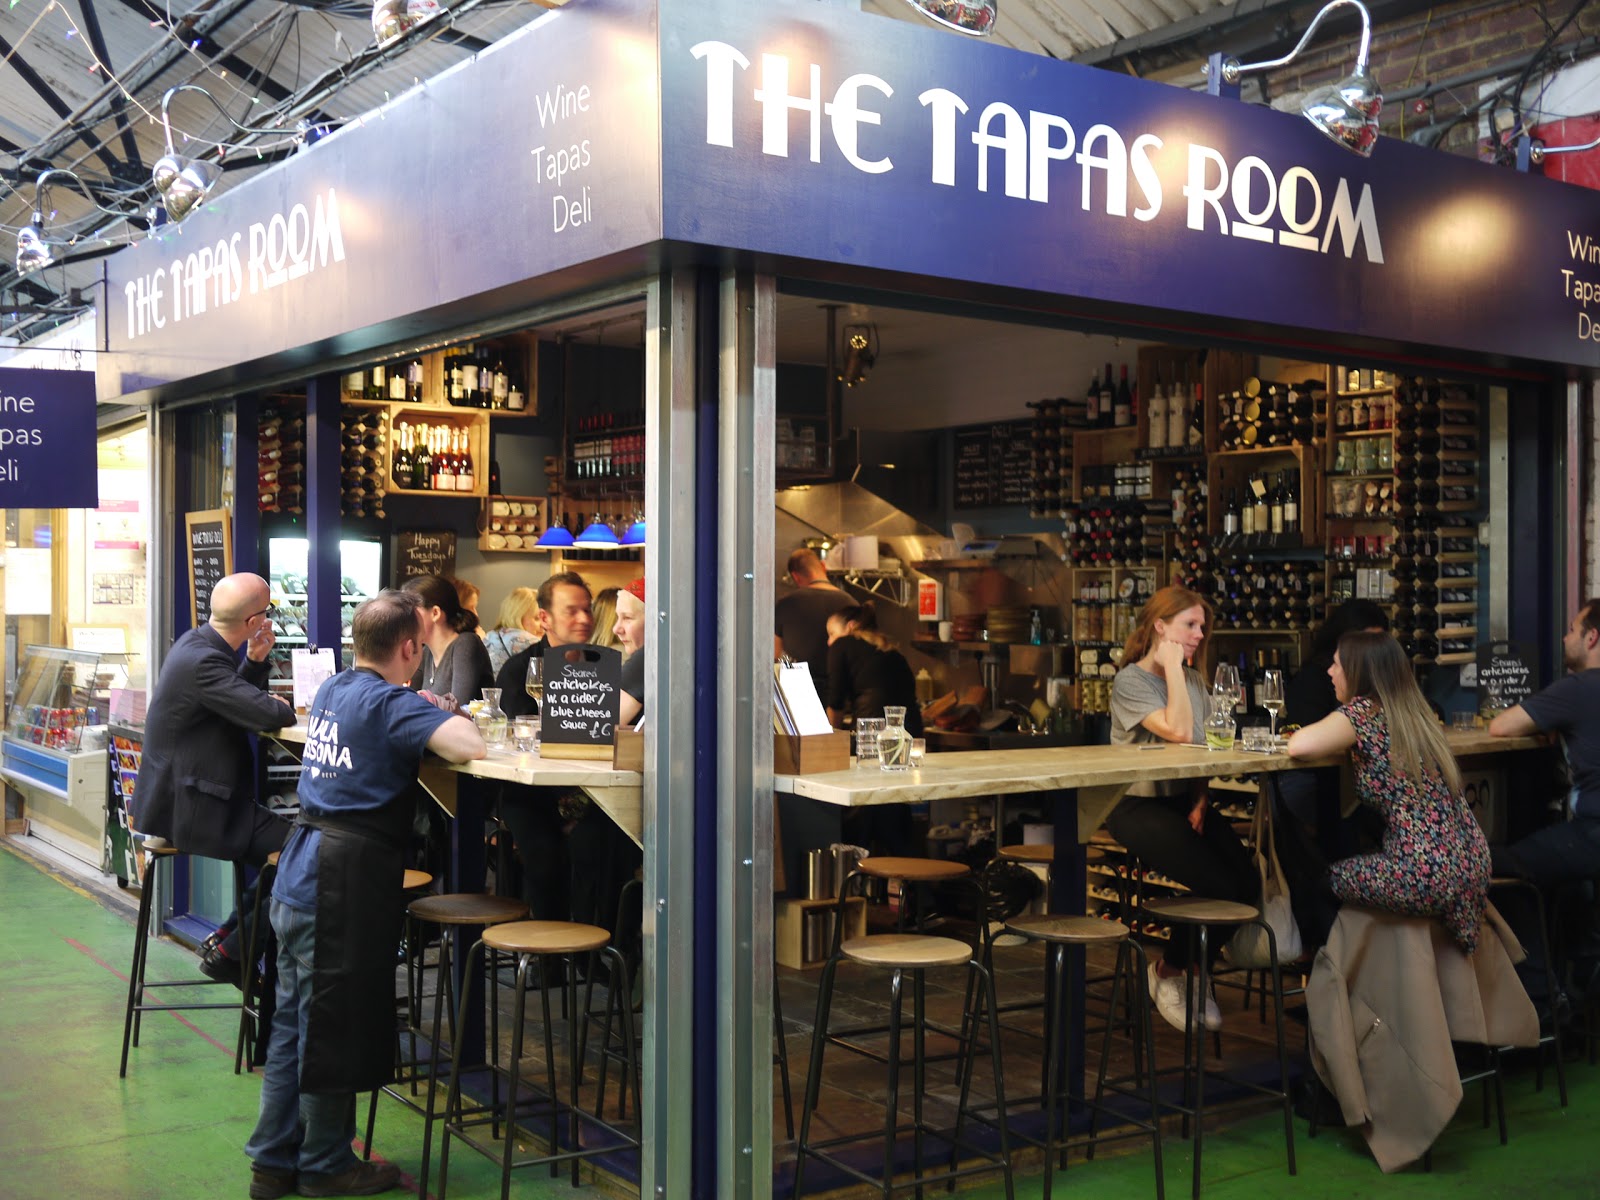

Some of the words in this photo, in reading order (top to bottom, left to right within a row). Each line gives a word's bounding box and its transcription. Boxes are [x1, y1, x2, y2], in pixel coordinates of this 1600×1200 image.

[535, 84, 591, 129] Wine
[530, 139, 591, 187] Tapas
[688, 40, 895, 175] THE
[918, 87, 1164, 223] TAPAS
[1182, 142, 1385, 266] ROOM
[552, 186, 592, 233] Deli
[1567, 230, 1600, 264] Win
[125, 267, 166, 340] THE
[170, 231, 242, 322] TAPAS
[247, 187, 346, 295] ROOM
[1560, 268, 1600, 308] Tapa
[1578, 311, 1600, 342] De
[0, 390, 35, 414] ine
[0, 428, 43, 450] pas
[414, 532, 440, 549] Happy
[549, 677, 614, 692] artichokes
[560, 694, 569, 704] a
[550, 706, 574, 718] blue
[575, 706, 612, 719] cheese
